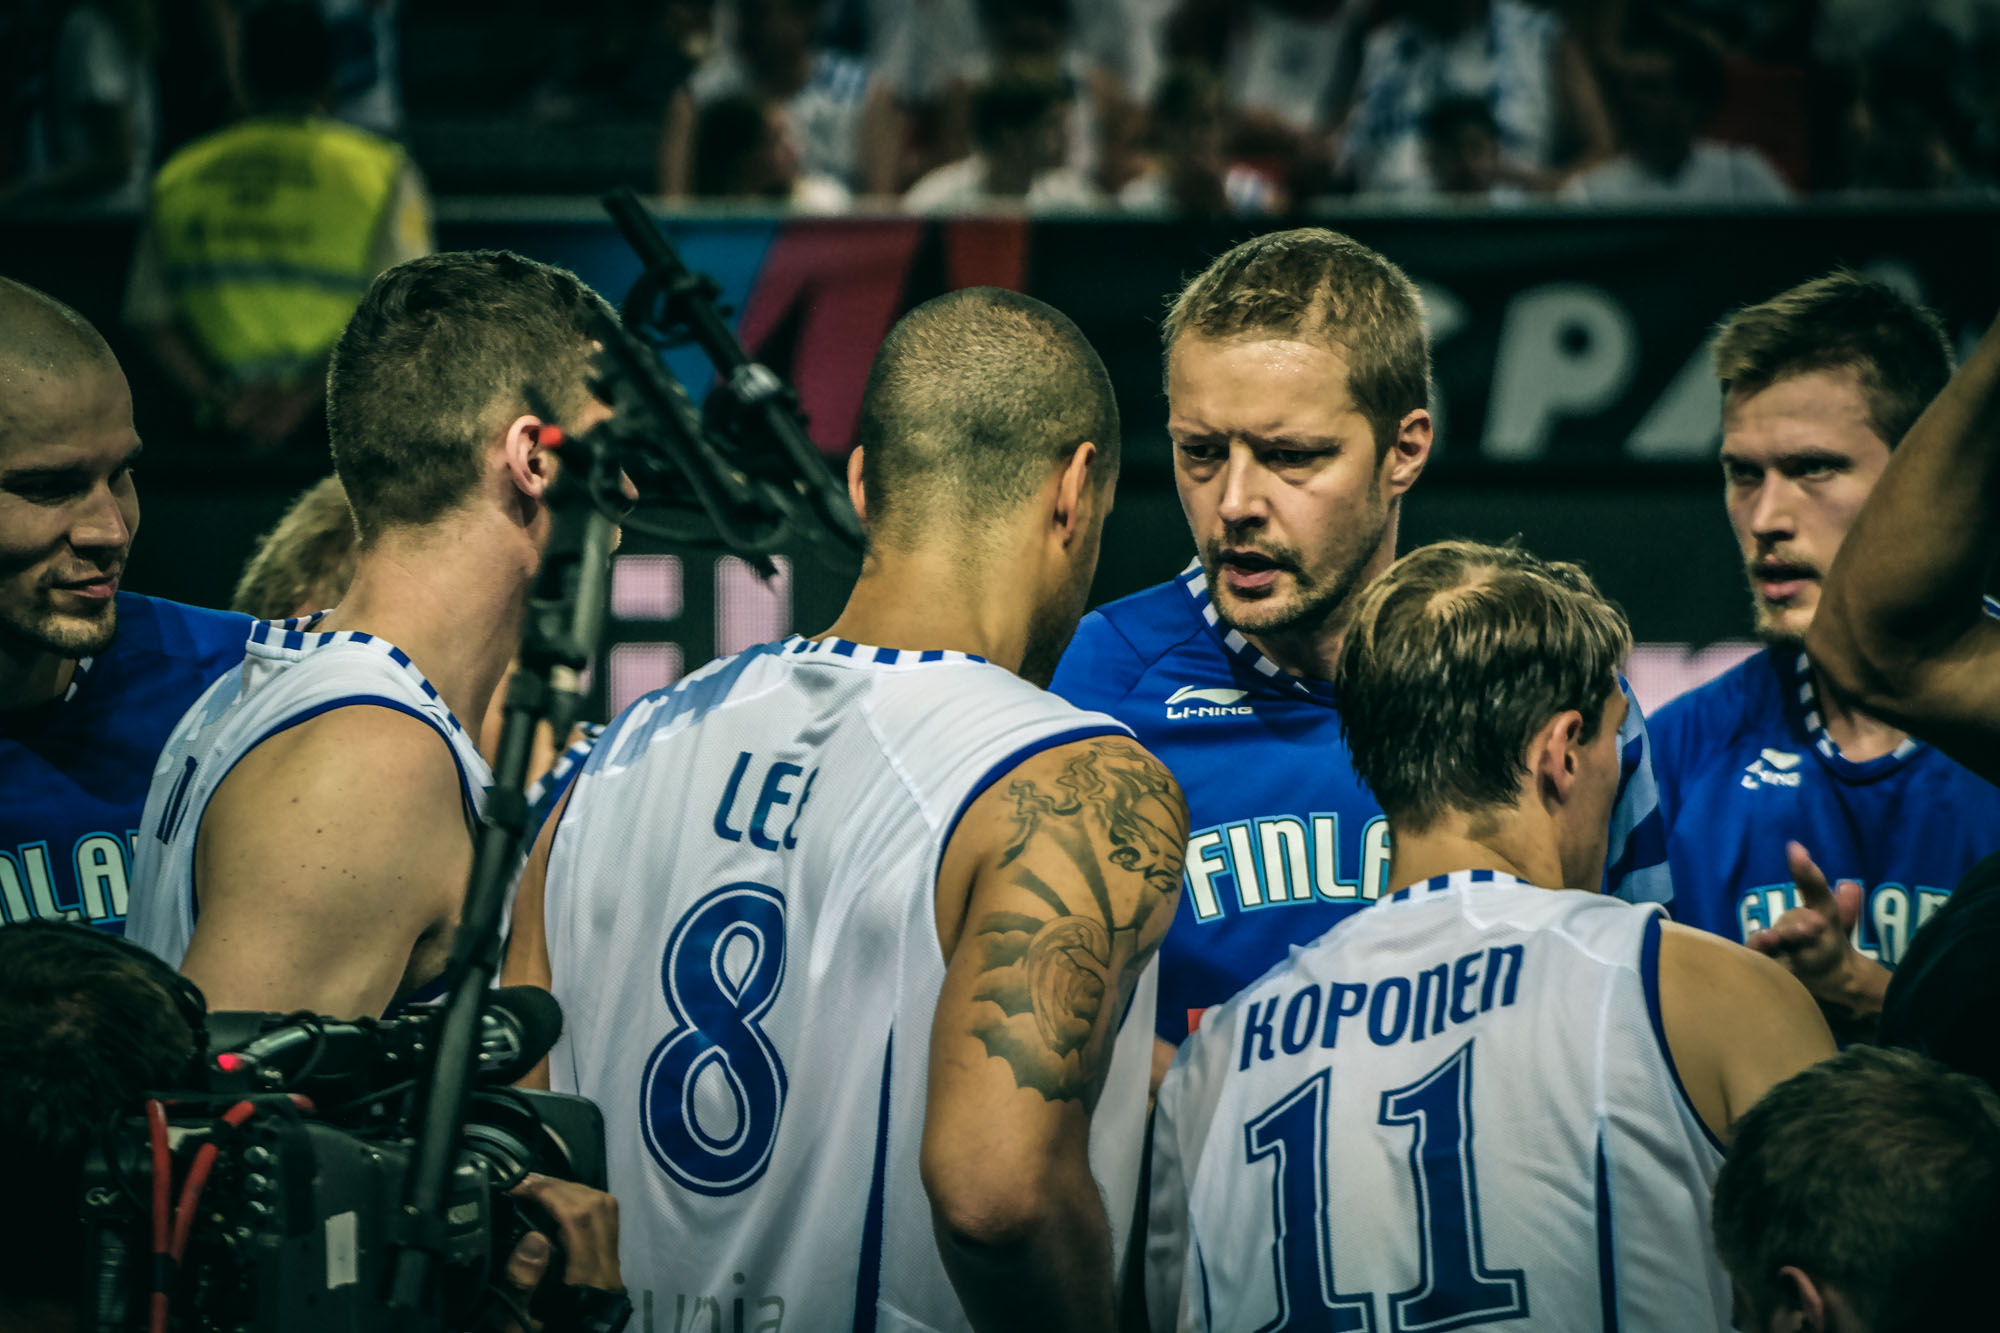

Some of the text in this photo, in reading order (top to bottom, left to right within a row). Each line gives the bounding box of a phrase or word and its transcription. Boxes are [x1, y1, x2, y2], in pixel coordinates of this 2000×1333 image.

[1165, 705, 1254, 720] LI-NING
[639, 881, 789, 1198] 8
[1239, 944, 1525, 1072] KOPONEN
[1244, 1036, 1531, 1333] 11
